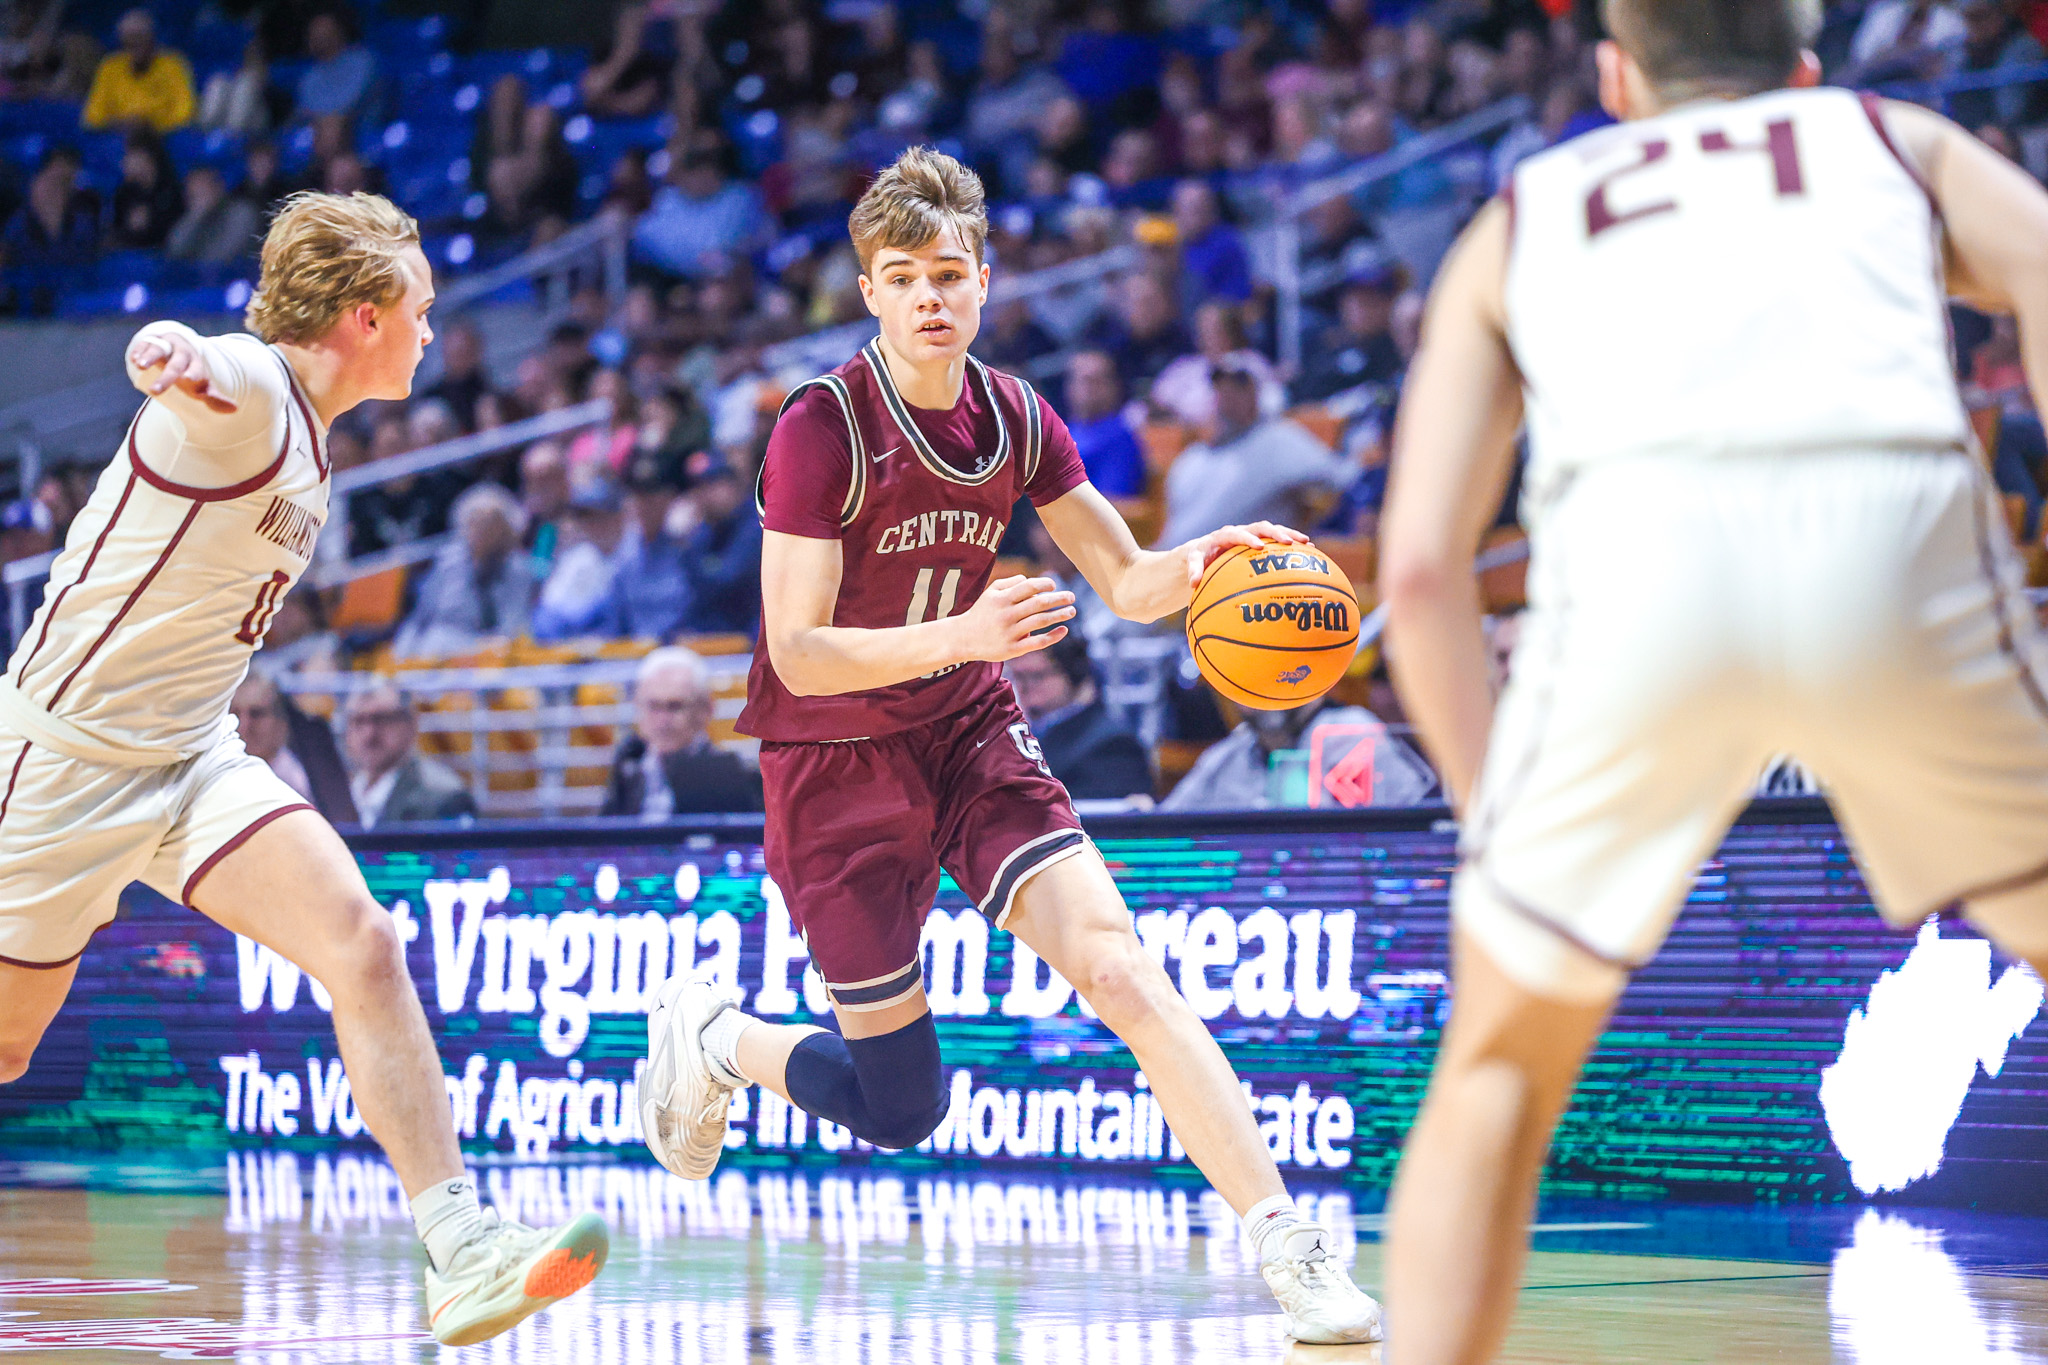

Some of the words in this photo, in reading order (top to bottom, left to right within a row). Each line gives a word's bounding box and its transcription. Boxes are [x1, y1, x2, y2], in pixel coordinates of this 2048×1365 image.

[1582, 116, 1807, 240] 24
[904, 566, 963, 627] 11
[1248, 552, 1331, 576] NCAA
[233, 569, 290, 646] 0
[1240, 600, 1350, 632] Wilson
[424, 861, 748, 1059] Virginia
[754, 874, 990, 1017] Fm
[1002, 906, 1361, 1020] reau
[218, 1049, 302, 1137] The
[1239, 1078, 1355, 1169] ate
